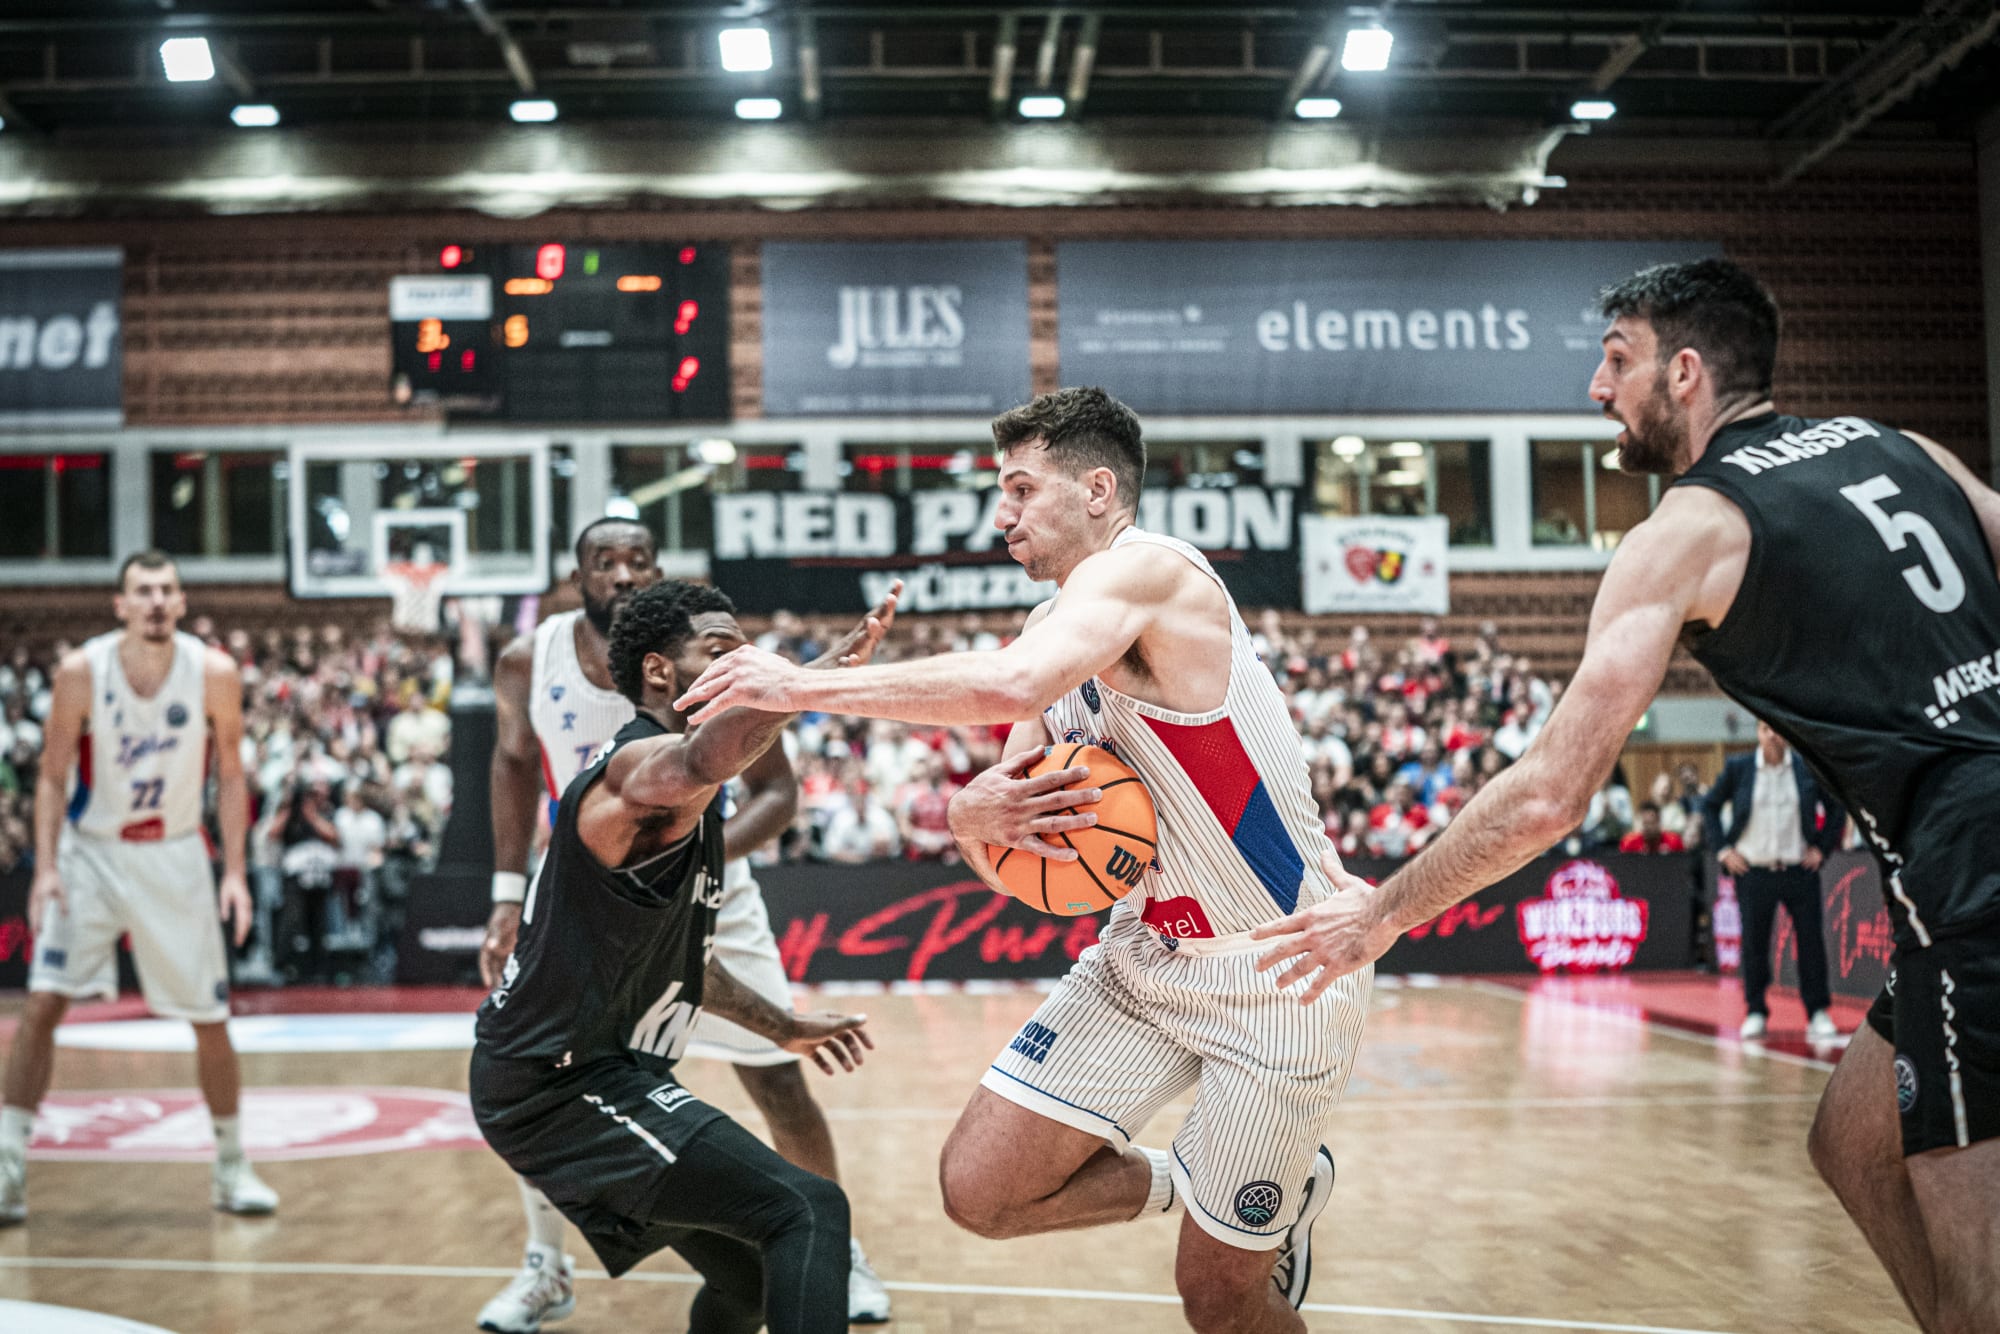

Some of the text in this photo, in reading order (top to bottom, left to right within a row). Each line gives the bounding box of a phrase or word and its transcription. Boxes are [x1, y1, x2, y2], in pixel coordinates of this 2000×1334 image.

[827, 286, 964, 369] JULES
[1256, 300, 1530, 351] elements
[714, 491, 897, 559] RED
[1839, 473, 1966, 613] 5
[1106, 844, 1147, 887] Wil
